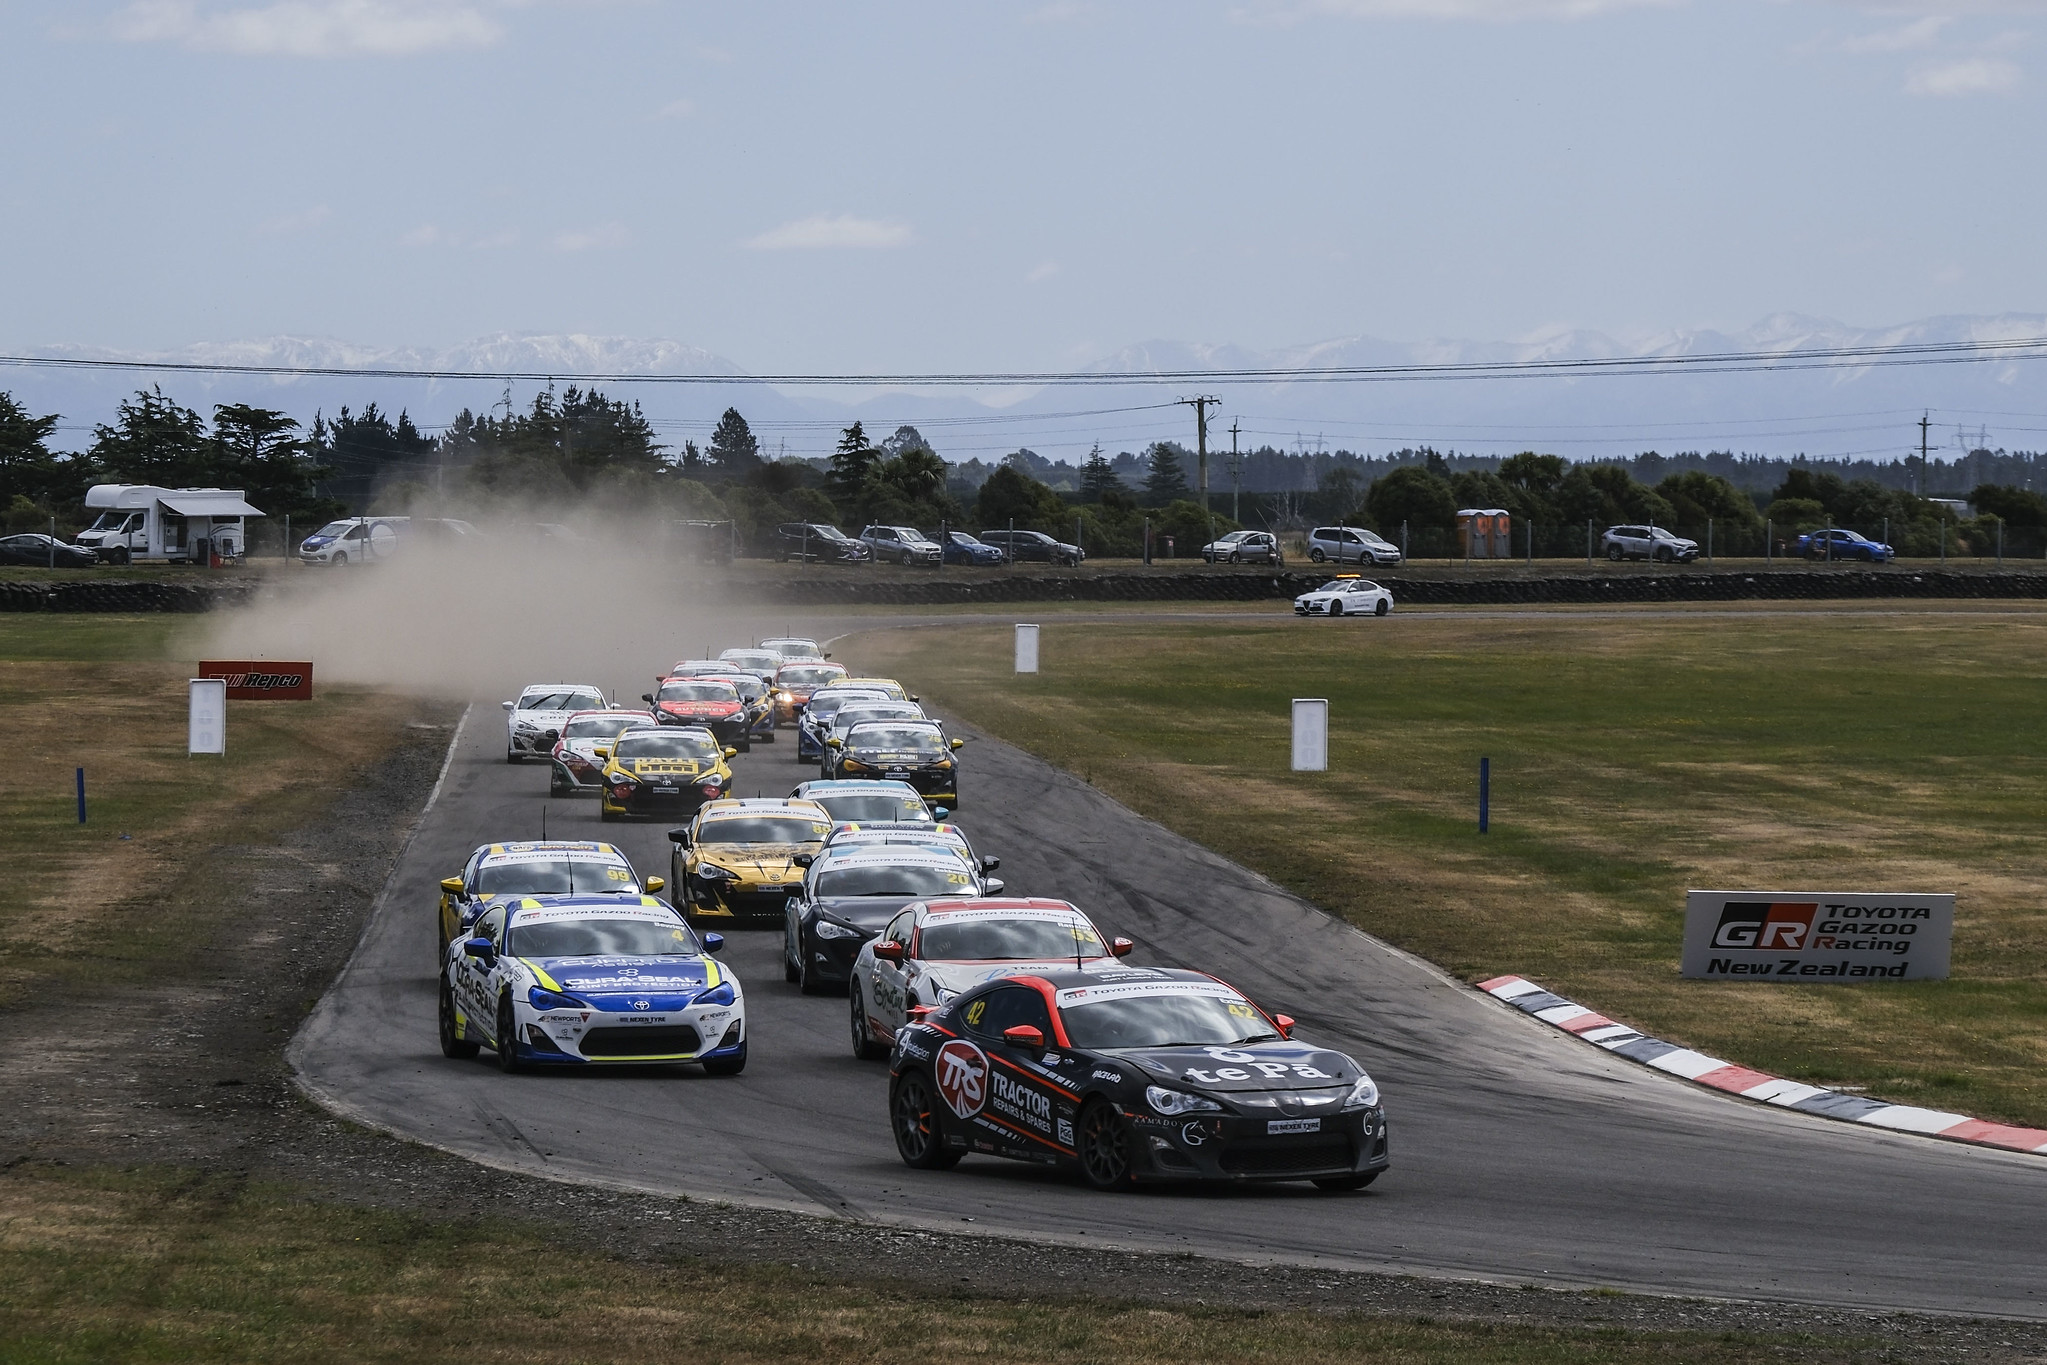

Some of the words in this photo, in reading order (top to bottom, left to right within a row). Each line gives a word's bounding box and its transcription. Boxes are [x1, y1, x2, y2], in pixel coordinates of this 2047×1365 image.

[244, 672, 302, 690] Repco
[903, 800, 922, 810] 22
[606, 869, 630, 882] 99
[946, 873, 969, 885] 20
[633, 911, 670, 919] Racing
[1824, 904, 1930, 919] TOYOTA
[1070, 928, 1098, 943] 53
[1715, 921, 1807, 948] GR
[1818, 921, 1917, 935] GAZOO
[671, 930, 684, 942] 4
[1812, 936, 1910, 955] Racing
[1707, 958, 1772, 975] New
[1776, 960, 1908, 977] Zealand
[565, 975, 697, 985] DURA-SEAL
[1091, 986, 1141, 995] TOYOTA
[1190, 985, 1230, 994] Racing
[551, 1015, 581, 1023] NEWPORTS
[967, 1001, 986, 1025] 42
[1228, 1004, 1258, 1020] 42
[943, 1051, 984, 1100] TRS
[992, 1071, 1051, 1120] TRACTOR
[993, 1098, 1019, 1117] REPAIRS
[1020, 1112, 1025, 1121] &
[1026, 1113, 1052, 1134] SPARES
[1303, 1122, 1320, 1130] TYRE
